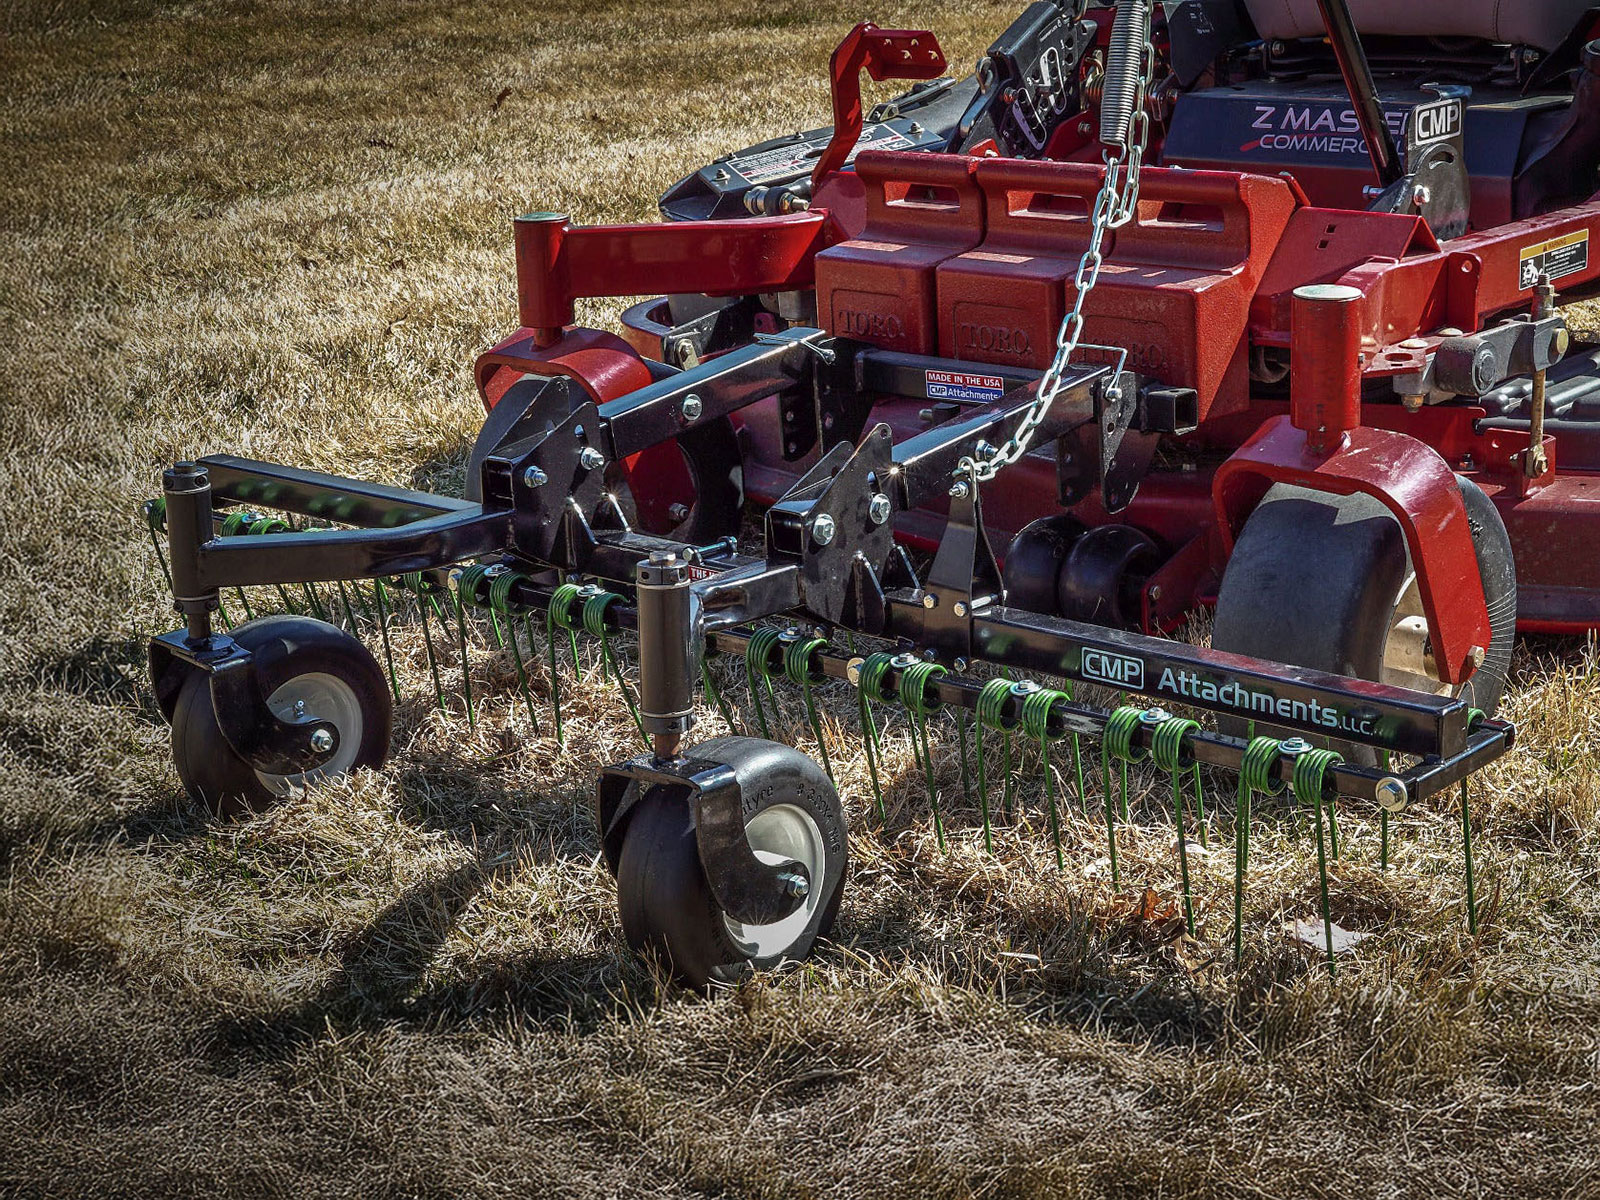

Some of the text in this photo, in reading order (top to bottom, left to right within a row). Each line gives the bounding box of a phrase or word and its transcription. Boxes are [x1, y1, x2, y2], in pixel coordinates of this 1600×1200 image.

[1252, 106, 1409, 135] Z MASE
[1419, 105, 1459, 138] CMP
[1260, 134, 1405, 156] COMMERCL
[928, 373, 1001, 388] MADE IN THE USA
[930, 386, 946, 395] CMP
[691, 568, 707, 578] THE
[1084, 652, 1141, 683] CMP
